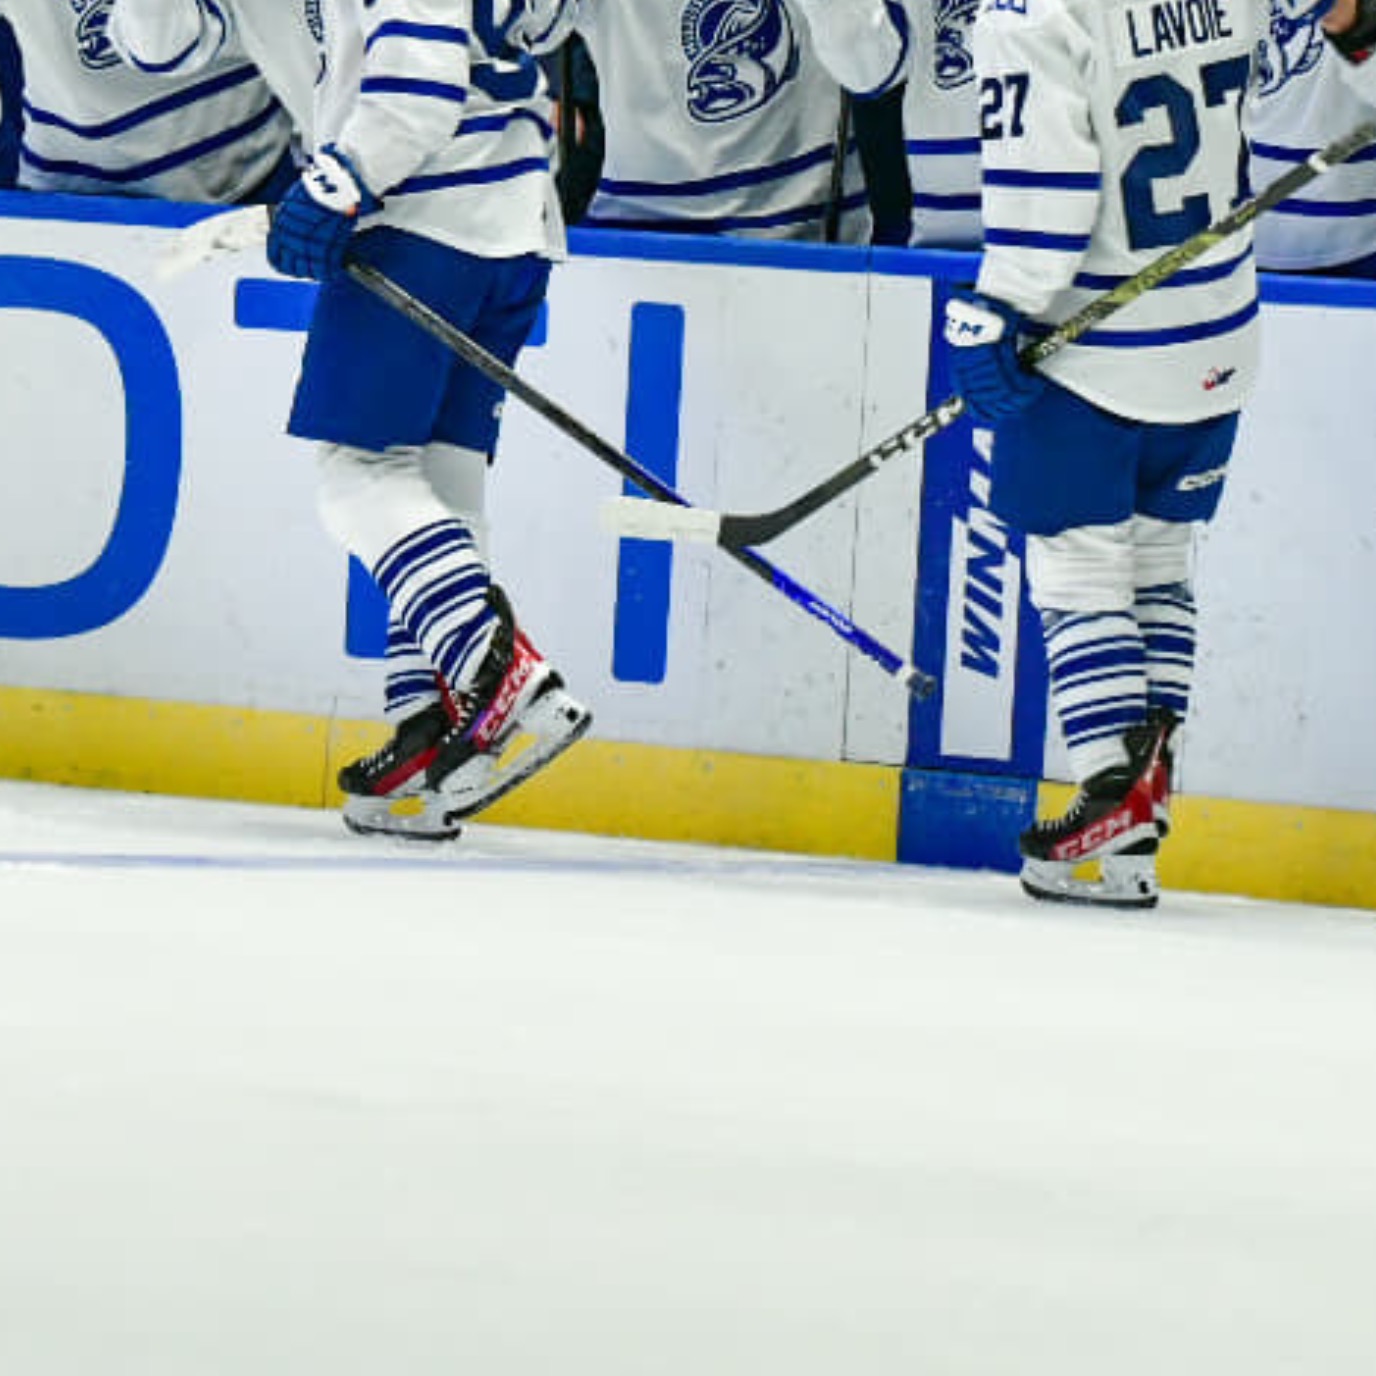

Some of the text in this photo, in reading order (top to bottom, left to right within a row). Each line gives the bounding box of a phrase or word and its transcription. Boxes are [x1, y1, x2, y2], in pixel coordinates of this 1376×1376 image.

[980, 72, 1030, 140] 27
[1114, 54, 1255, 252] 27
[1051, 809, 1135, 862] CCM
